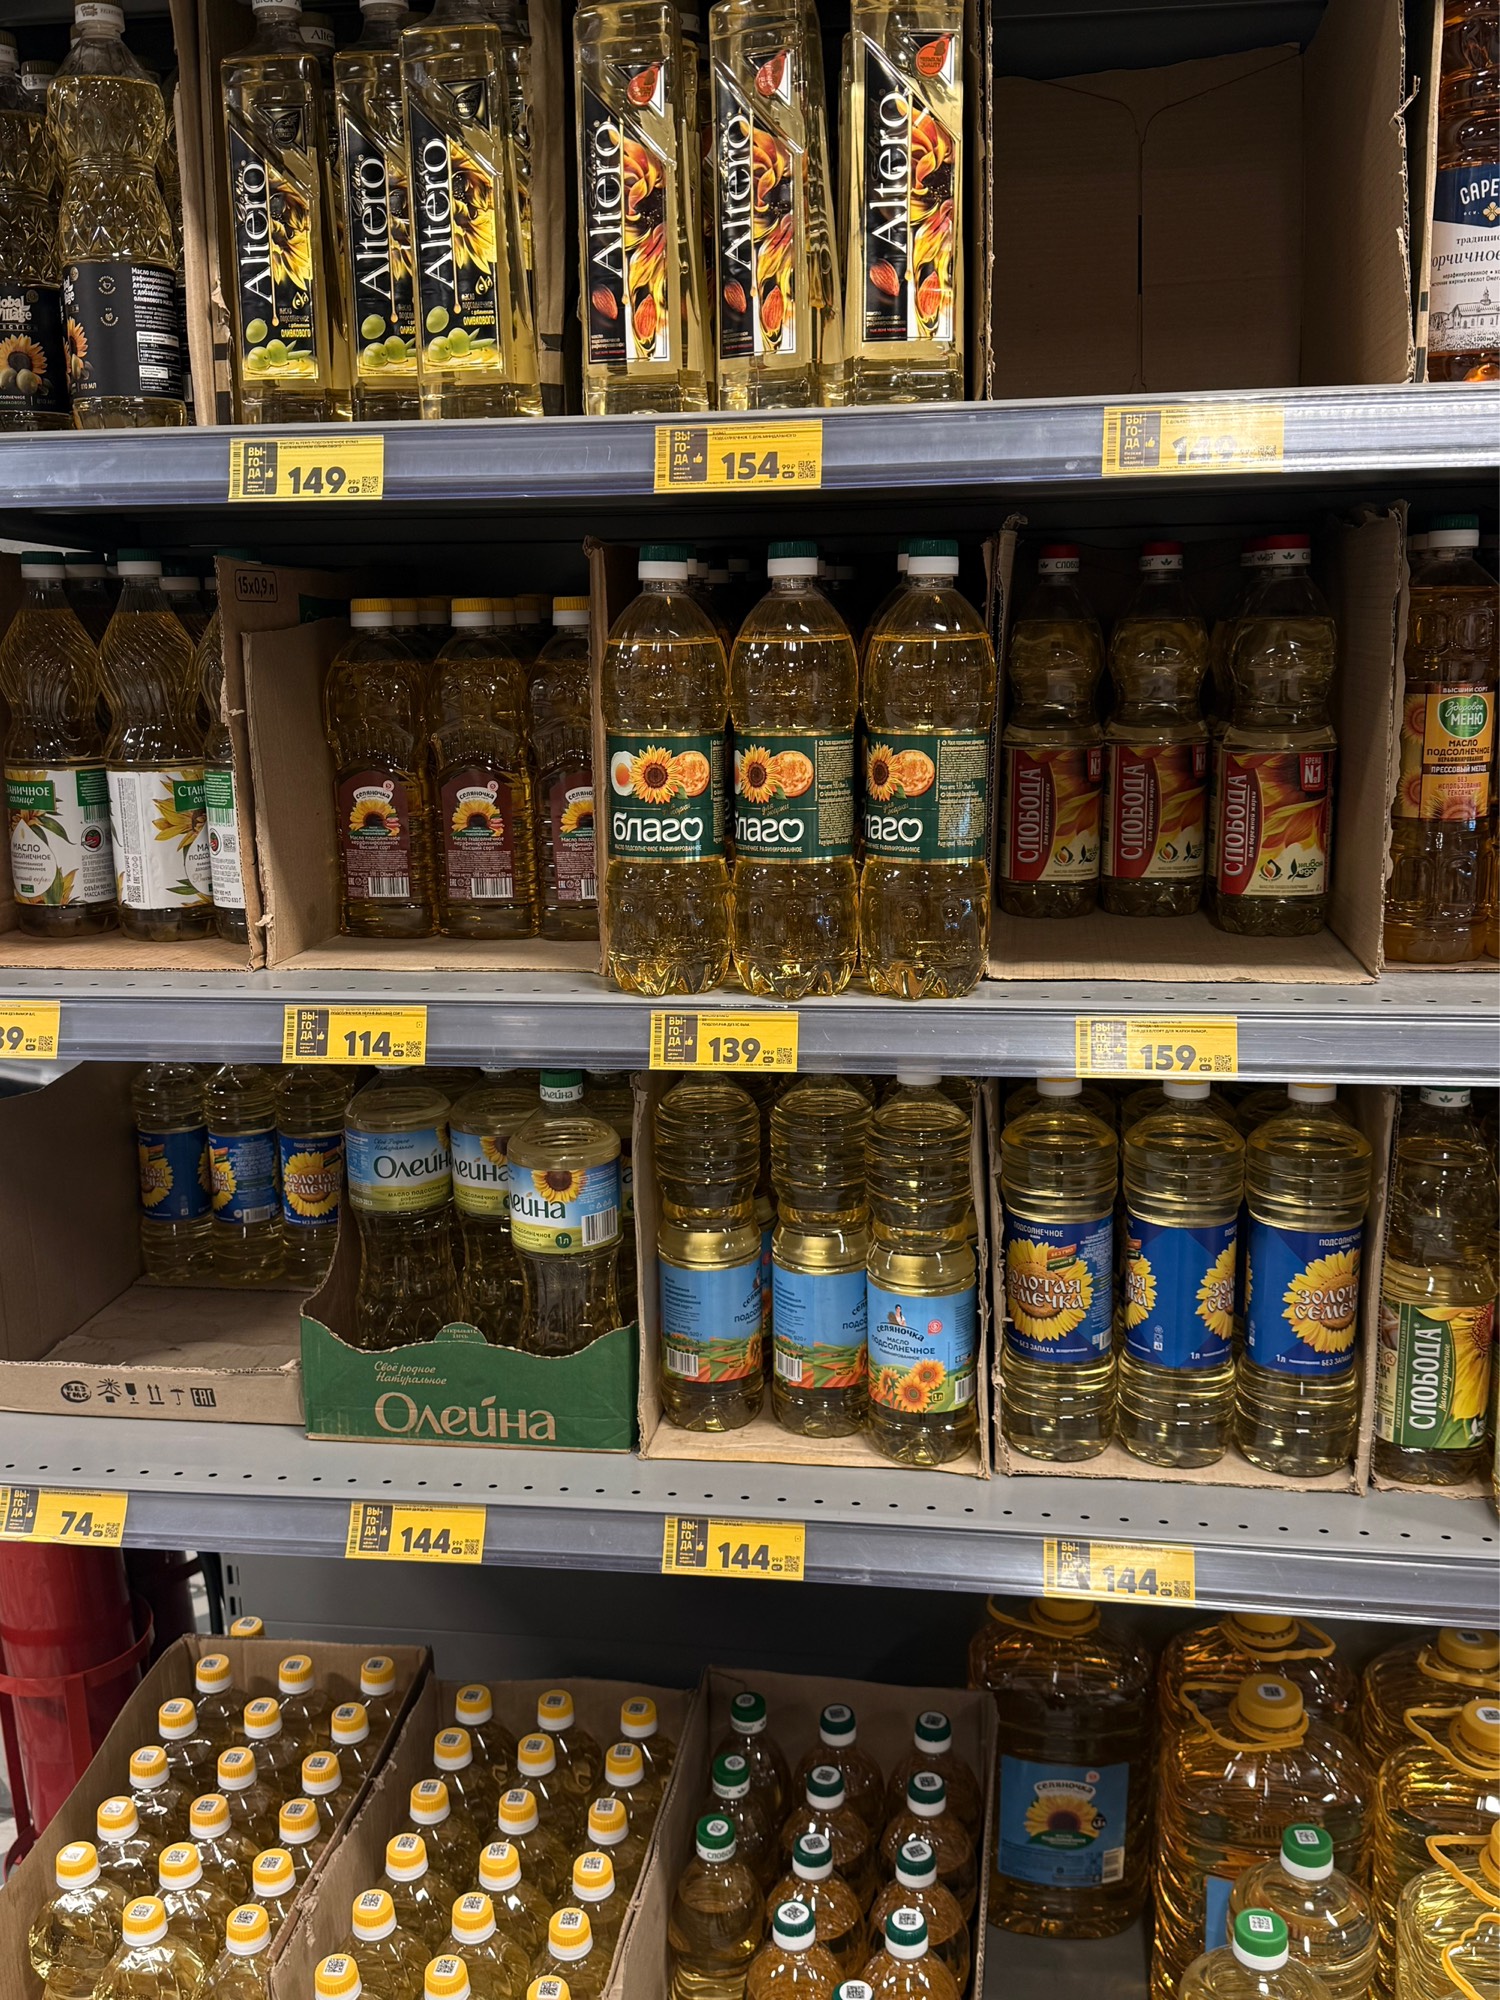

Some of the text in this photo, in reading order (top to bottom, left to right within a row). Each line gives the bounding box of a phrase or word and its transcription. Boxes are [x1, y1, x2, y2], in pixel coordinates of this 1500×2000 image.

[869, 91, 907, 254] Altero
[722, 113, 751, 271] Altero
[1460, 178, 1500, 205] САРЕ
[589, 123, 622, 279] Altero
[421, 139, 454, 290] Altero
[240, 163, 273, 304] Altero
[356, 158, 392, 300] Altero
[1431, 249, 1500, 271] орчичное
[463, 316, 495, 326] ОЛИВКОВОГО
[281, 329, 311, 338] ОЛИВКОВОГО
[1125, 413, 1147, 425] ВЫ-
[674, 431, 694, 442] ВЫ-
[1125, 425, 1143, 436] ГО-
[248, 446, 267, 457] ВЫ-
[674, 443, 691, 453] ГО-
[1124, 439, 1140, 450] ДА
[248, 457, 264, 467] ГО-
[673, 454, 689, 466] ДА
[721, 451, 780, 480] 154
[247, 467, 261, 479] ДА
[287, 466, 346, 495] 149
[1445, 700, 1484, 717] Здоровое
[1450, 712, 1484, 726] МЕНЮ
[1448, 739, 1478, 747] МАСЛО
[1426, 746, 1490, 756] ПОДСОЛНЕЧНОЕ
[1430, 764, 1487, 773] ПРЕССОВЫЙ МЕТОД
[7, 785, 50, 797] ТАНИЧНОЕ
[355, 789, 391, 800] селяночка
[459, 789, 495, 800] селяночка
[568, 789, 594, 800] селяно
[1017, 767, 1041, 864] СЛОБОДА
[1120, 763, 1146, 861] СЛОБОДА
[613, 812, 704, 843] благо
[735, 813, 805, 843] лаго
[864, 815, 923, 843] лаго
[1223, 774, 1247, 877] СЛОБОДА
[13, 843, 41, 853] МАСЛО
[301, 1012, 319, 1021] ВЫ-
[669, 1016, 686, 1026] ВЫ-
[301, 1021, 315, 1030] ГО-
[668, 1026, 683, 1036] ГО-
[300, 1031, 313, 1041] ДА
[667, 1036, 681, 1047] ДА
[343, 1030, 391, 1057] 114
[708, 1036, 761, 1063] 139
[1139, 1044, 1197, 1071] 159
[540, 1086, 573, 1100] Олейна
[373, 1148, 451, 1180] Олейн
[453, 1157, 509, 1182] лейна
[1013, 1221, 1064, 1238] ПОДСОЛНЕЧНОЕ
[557, 1235, 569, 1246] 1л
[1297, 1285, 1357, 1305] ЗОЛОТ
[876, 1324, 925, 1343] селяночка
[886, 1336, 909, 1346] МАСЛО
[1019, 1339, 1054, 1354] БЕЗ ЗАПАХА
[1190, 1351, 1200, 1360] 1л
[1275, 1353, 1333, 1367] 1л БЕЗ
[374, 1360, 436, 1375] Своё родное
[376, 1372, 447, 1386] Натуральное
[1408, 1327, 1442, 1430] СЛОБОДА
[1438, 1343, 1450, 1412] Масло подсолнечное
[374, 1391, 557, 1441] Олейна
[14, 1490, 30, 1498] ВЫ-
[11, 1508, 23, 1518] ДА
[366, 1506, 383, 1516] ВЫ-
[60, 1510, 94, 1536] 74
[365, 1516, 380, 1525] ГО-
[681, 1520, 698, 1530] ВЫ-
[364, 1525, 377, 1536] ДА
[680, 1530, 695, 1540] ГО-
[400, 1526, 451, 1554] 144
[680, 1540, 693, 1551] ДА
[1061, 1541, 1080, 1552] ВЫ-
[717, 1541, 770, 1571] 144
[1102, 1564, 1159, 1596] 144
[1036, 1781, 1094, 1795] селяночка
